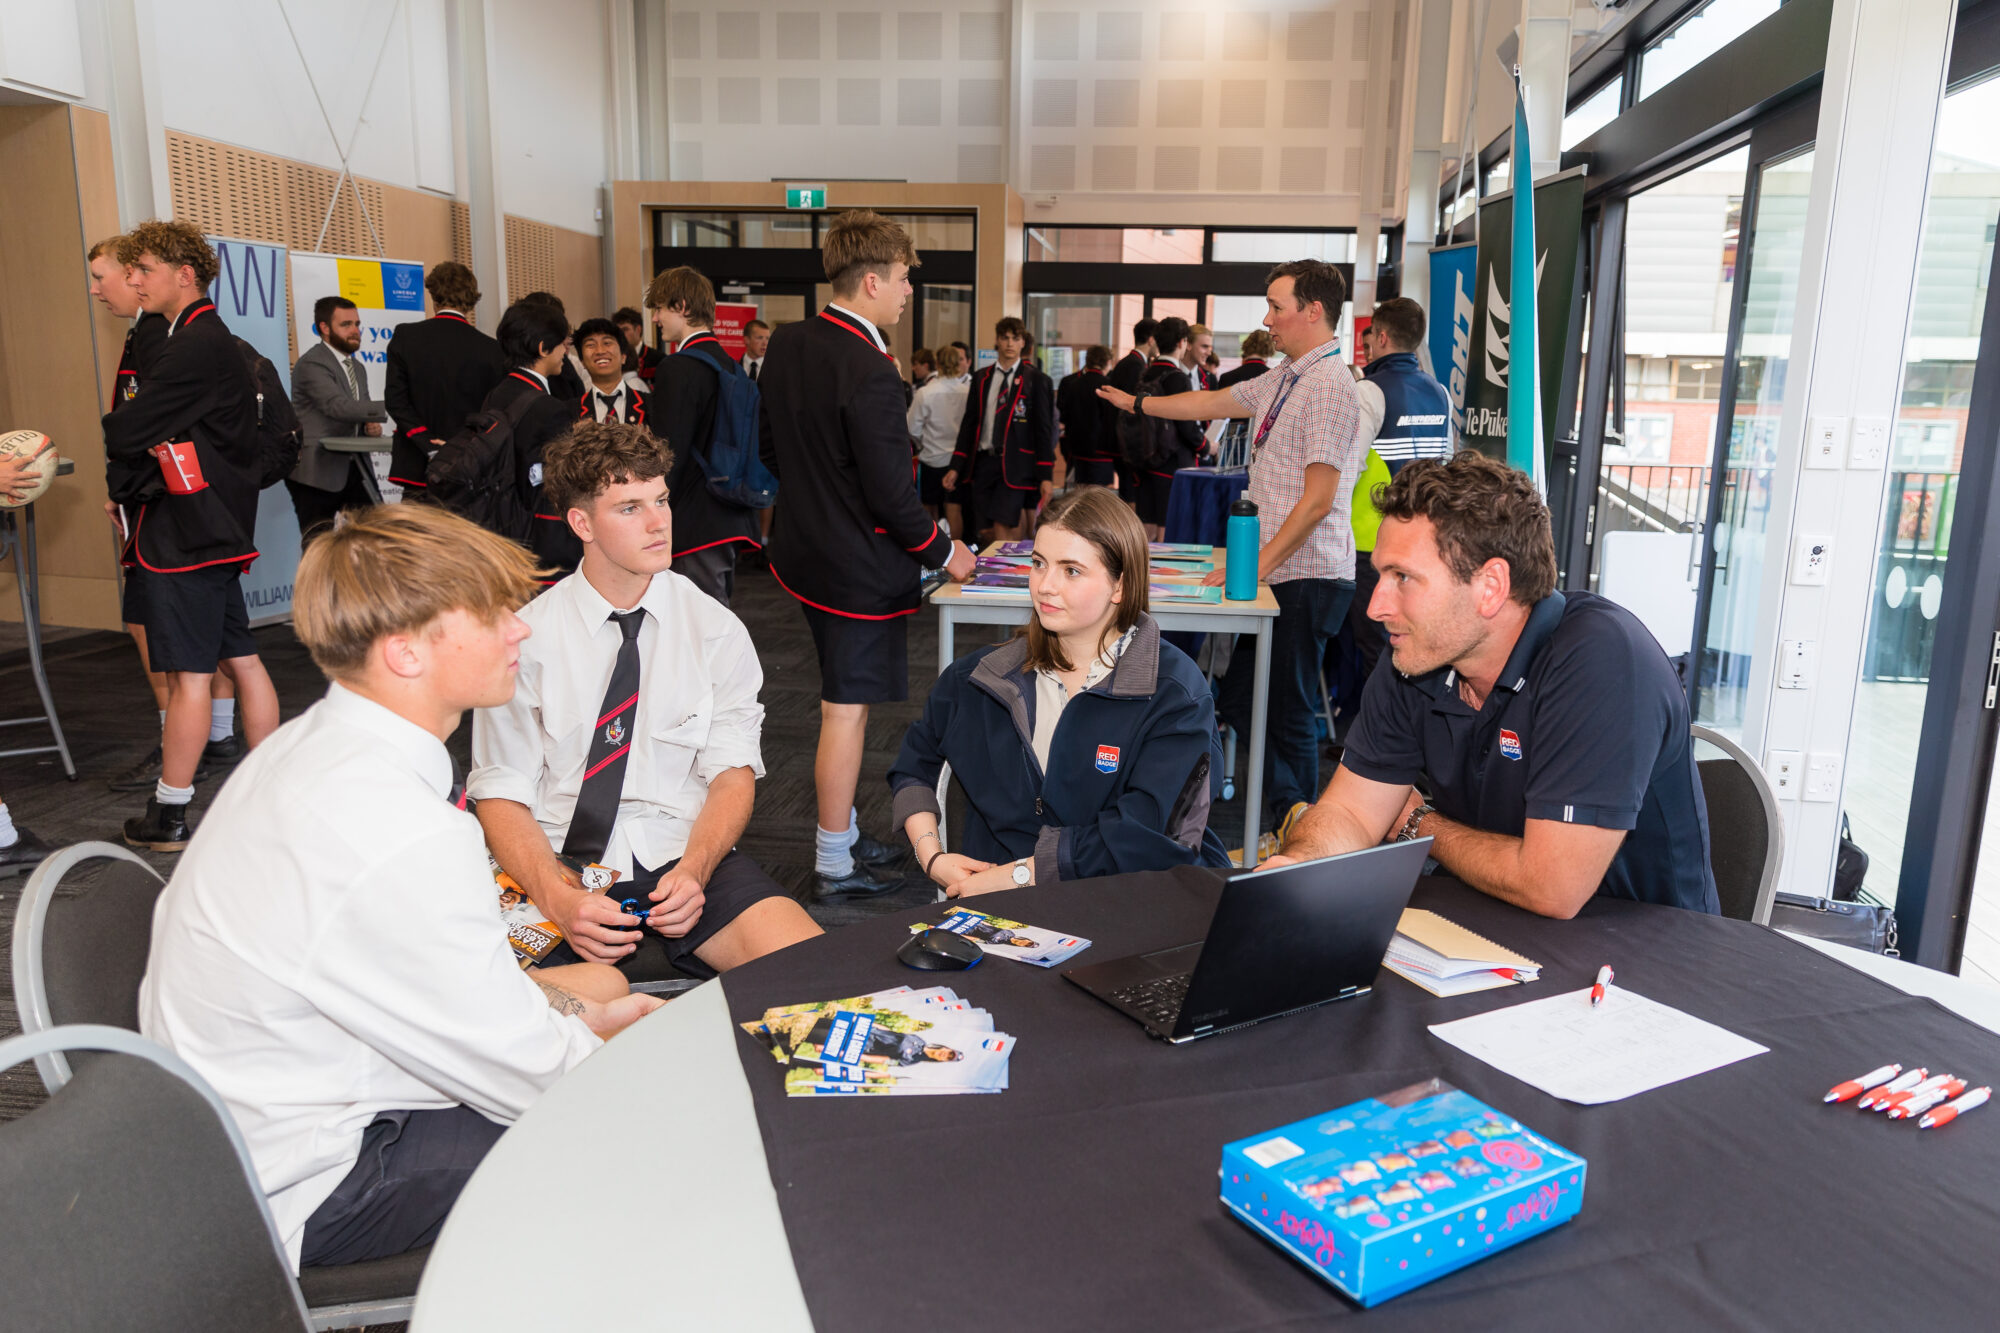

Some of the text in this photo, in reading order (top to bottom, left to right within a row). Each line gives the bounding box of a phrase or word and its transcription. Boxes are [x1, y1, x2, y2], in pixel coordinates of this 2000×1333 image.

[360, 350, 388, 363] wa
[1466, 407, 1479, 435] Te
[1502, 737, 1519, 748] RED
[1098, 752, 1117, 761] RED
[1097, 760, 1117, 768] BADGE
